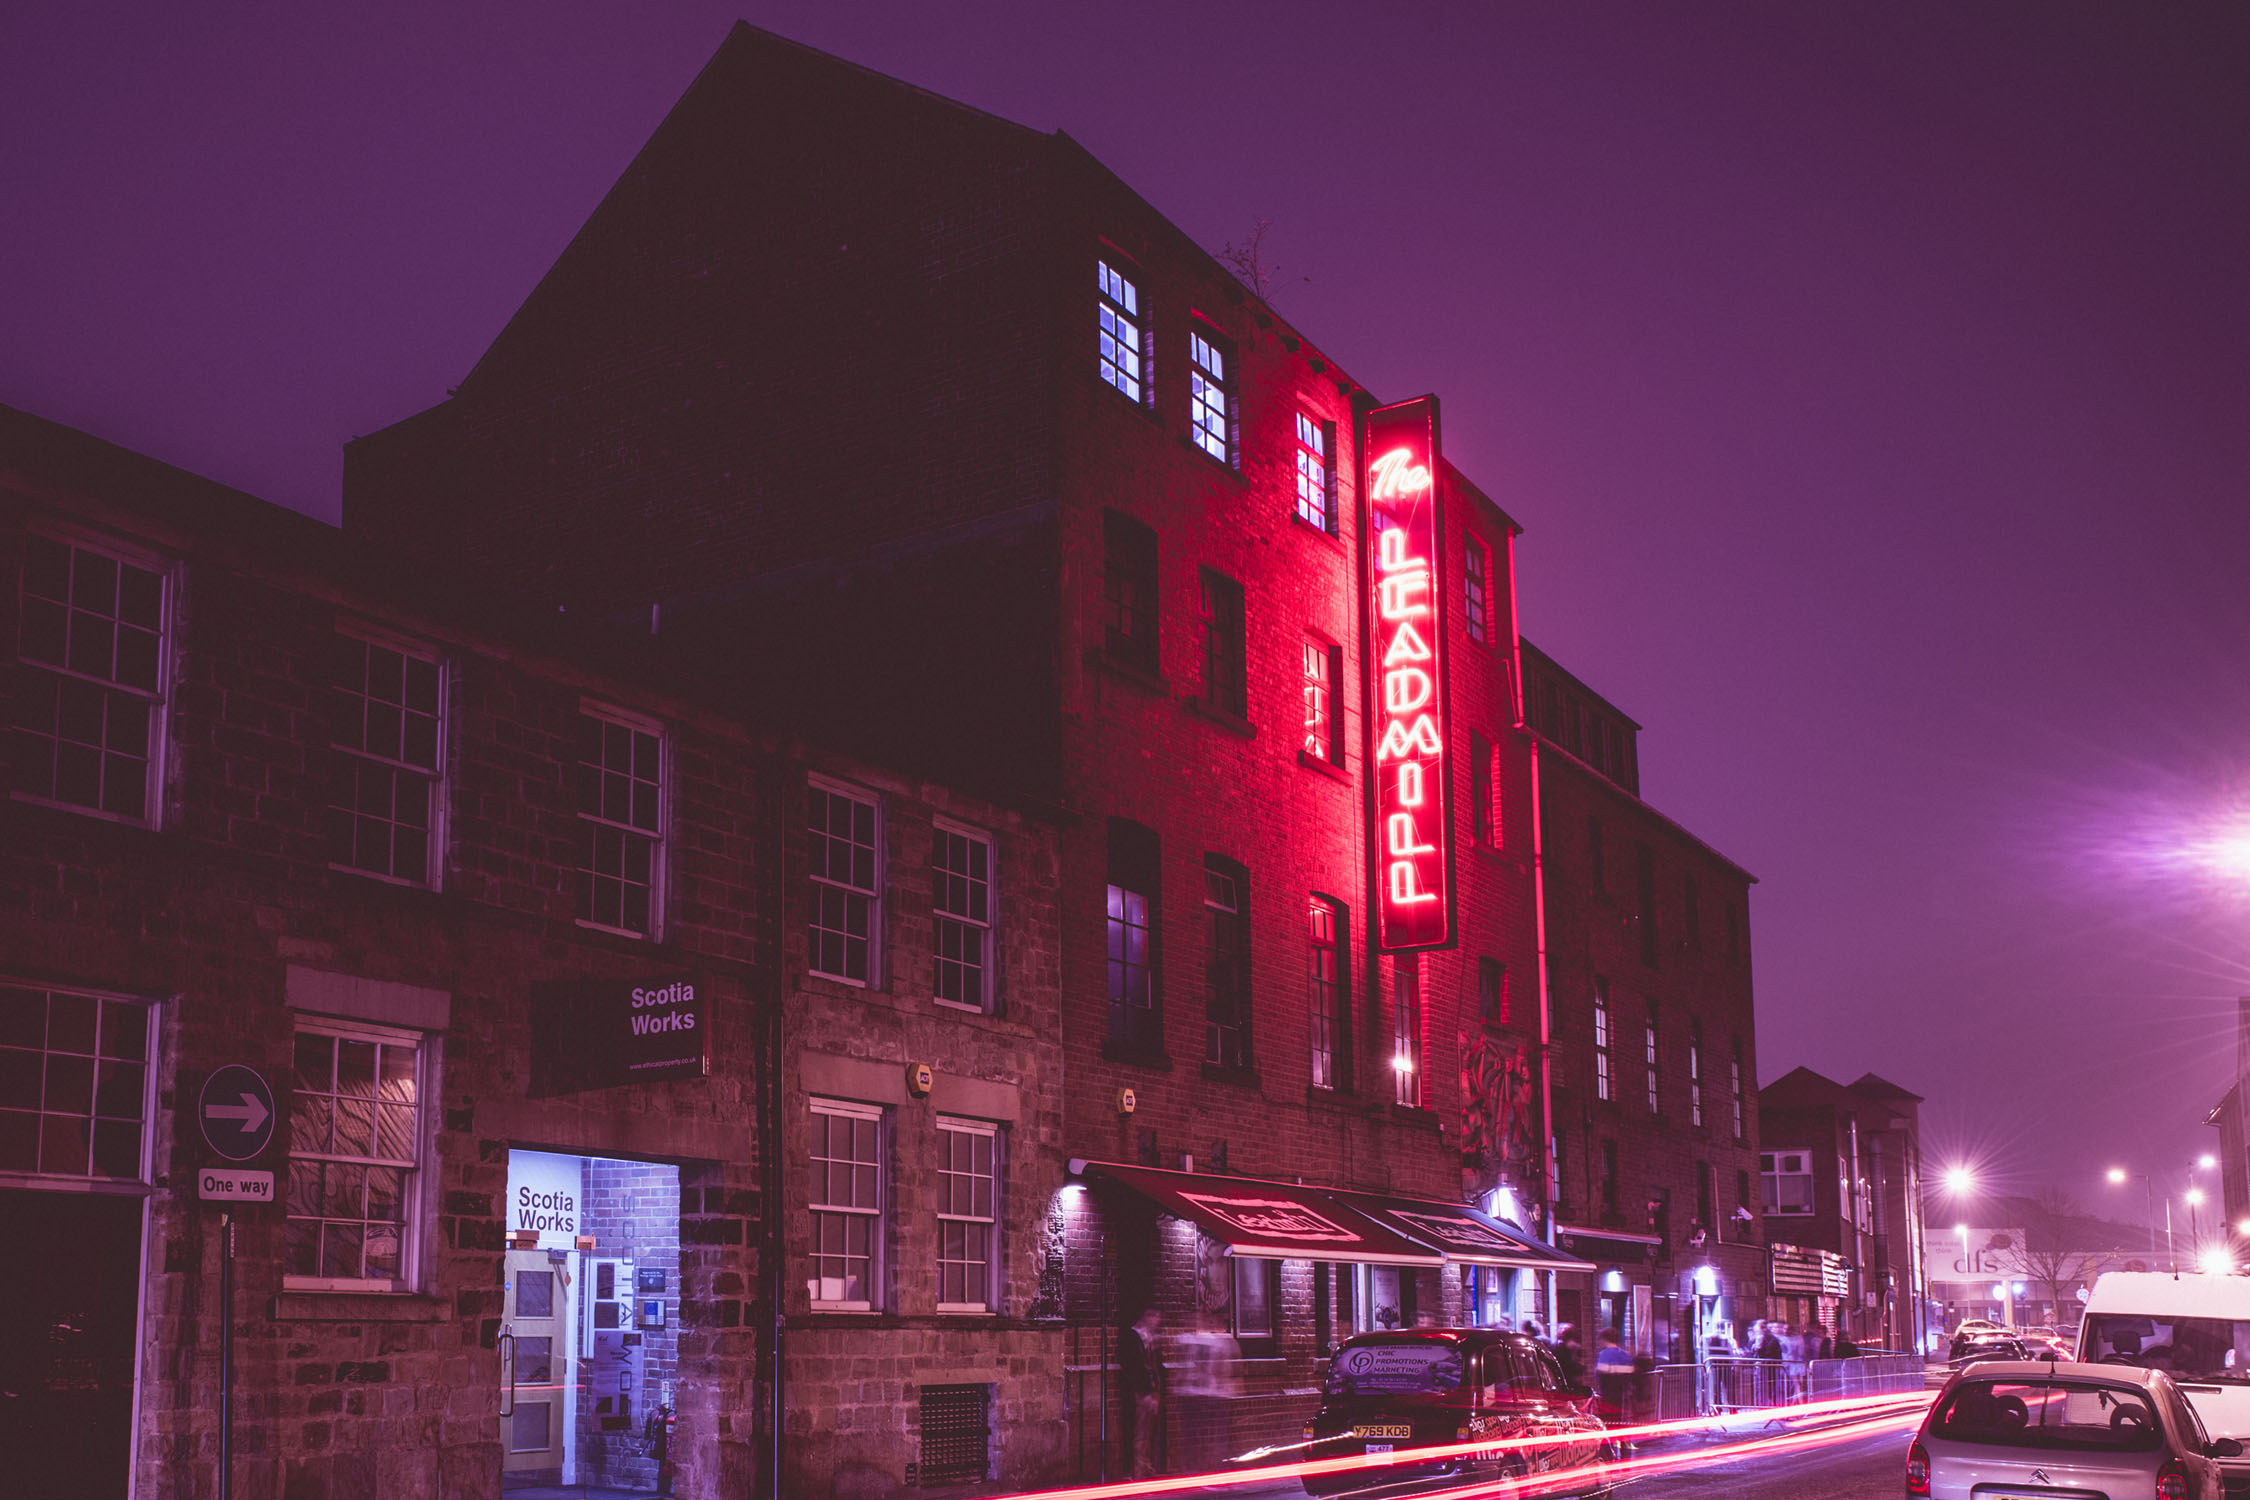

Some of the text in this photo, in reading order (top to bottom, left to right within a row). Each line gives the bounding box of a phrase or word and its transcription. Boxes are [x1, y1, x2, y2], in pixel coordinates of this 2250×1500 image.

[1371, 448, 1431, 500] The
[1378, 527, 1441, 904] LEADMILL
[631, 981, 694, 1008] Scotia
[630, 1010, 695, 1036] Works
[203, 1176, 269, 1196] One way
[518, 1186, 574, 1212] Scotia
[518, 1208, 575, 1232] Works
[1953, 1247, 1999, 1274] dfs
[1373, 1366, 1420, 1374] MARKETING
[1375, 1358, 1428, 1366] PROMOTIONS
[1354, 1426, 1384, 1437] Y769
